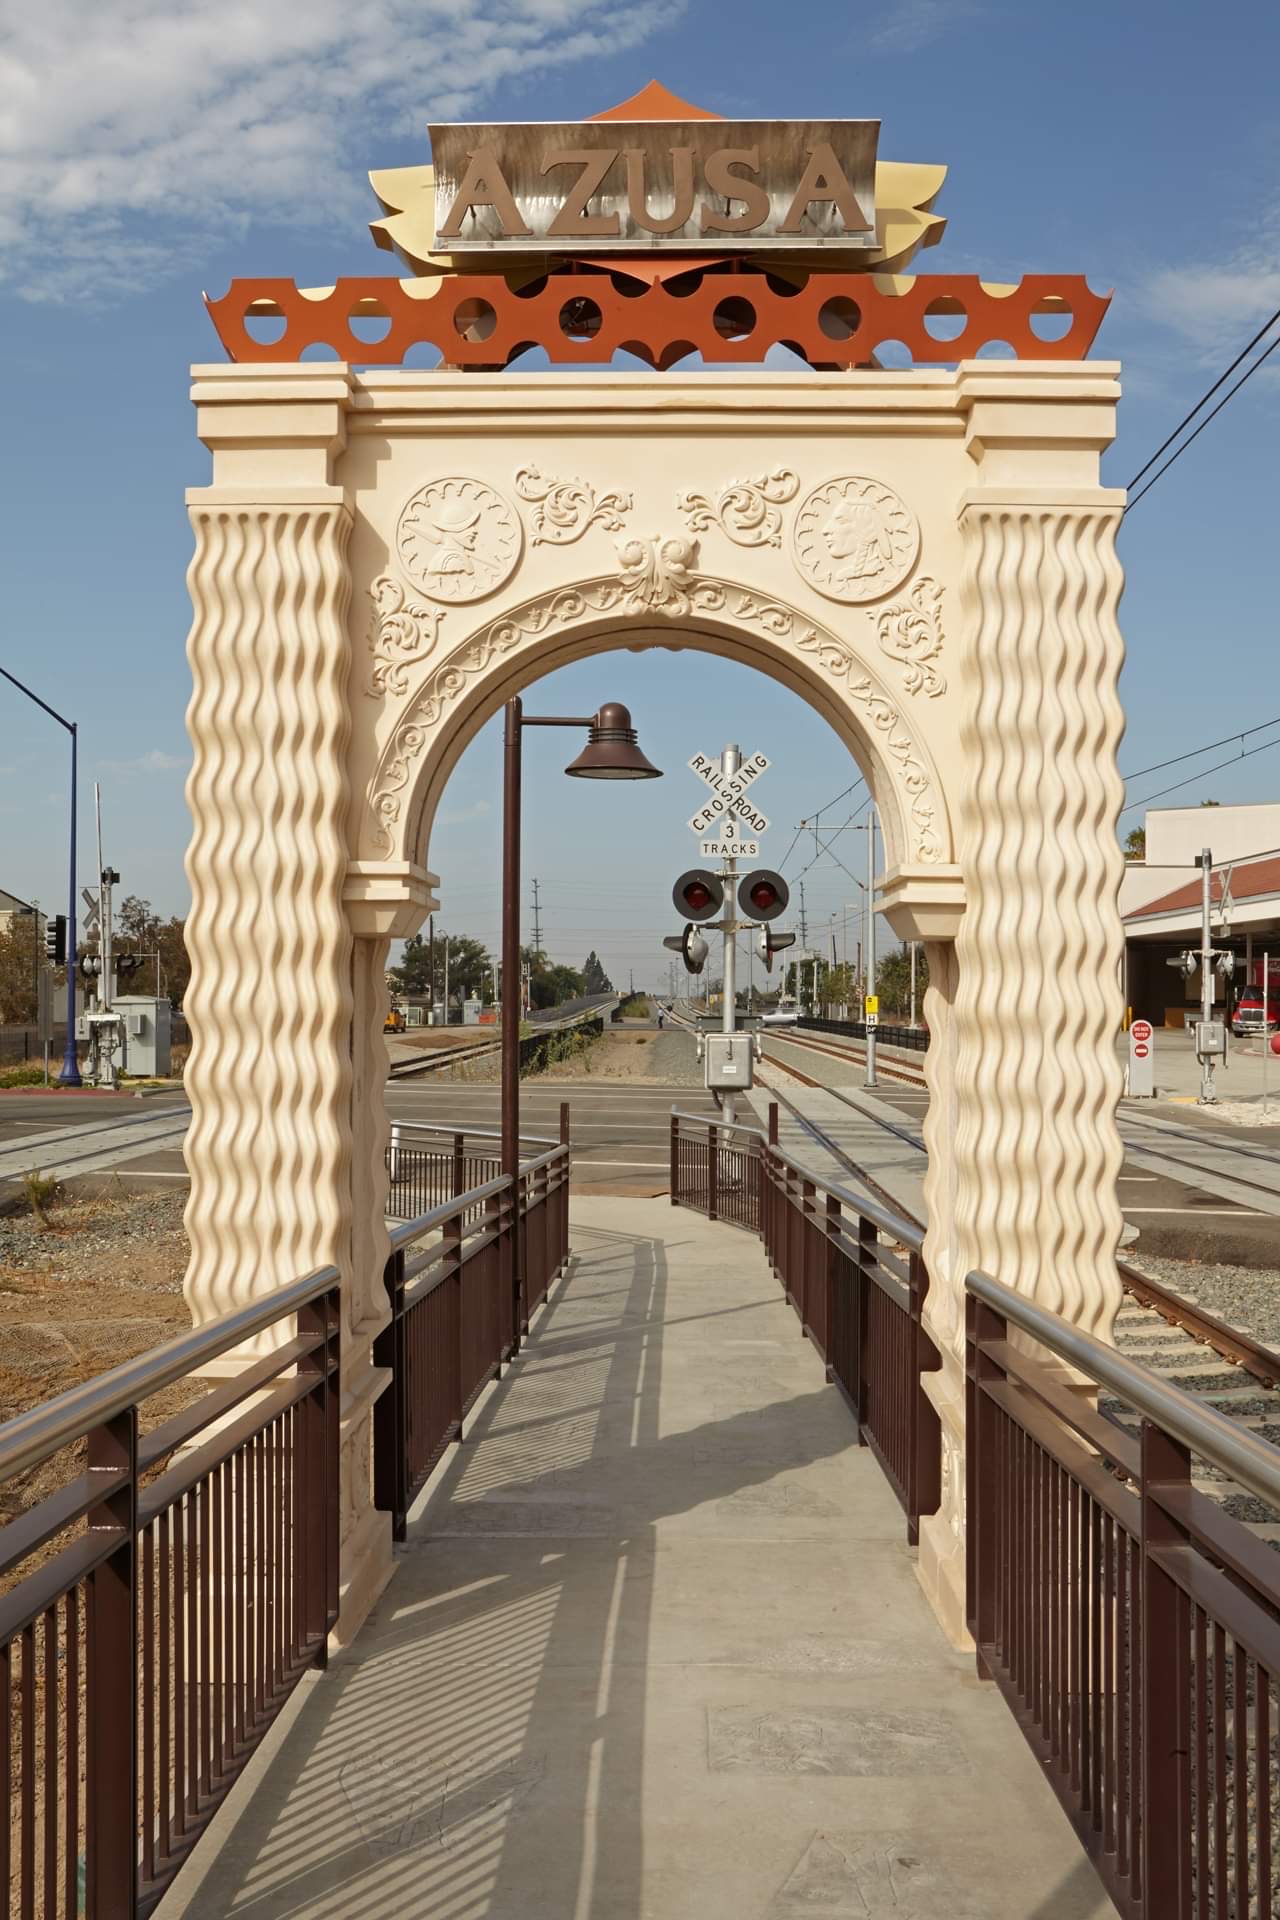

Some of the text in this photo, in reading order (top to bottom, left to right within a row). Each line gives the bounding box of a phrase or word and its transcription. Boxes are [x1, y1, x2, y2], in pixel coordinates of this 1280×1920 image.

[436, 142, 874, 237] AZUSA
[691, 756, 766, 832] RAILROAD
[692, 755, 767, 831] CROSSING
[703, 843, 756, 854] TRACKS
[725, 825, 734, 838] 3
